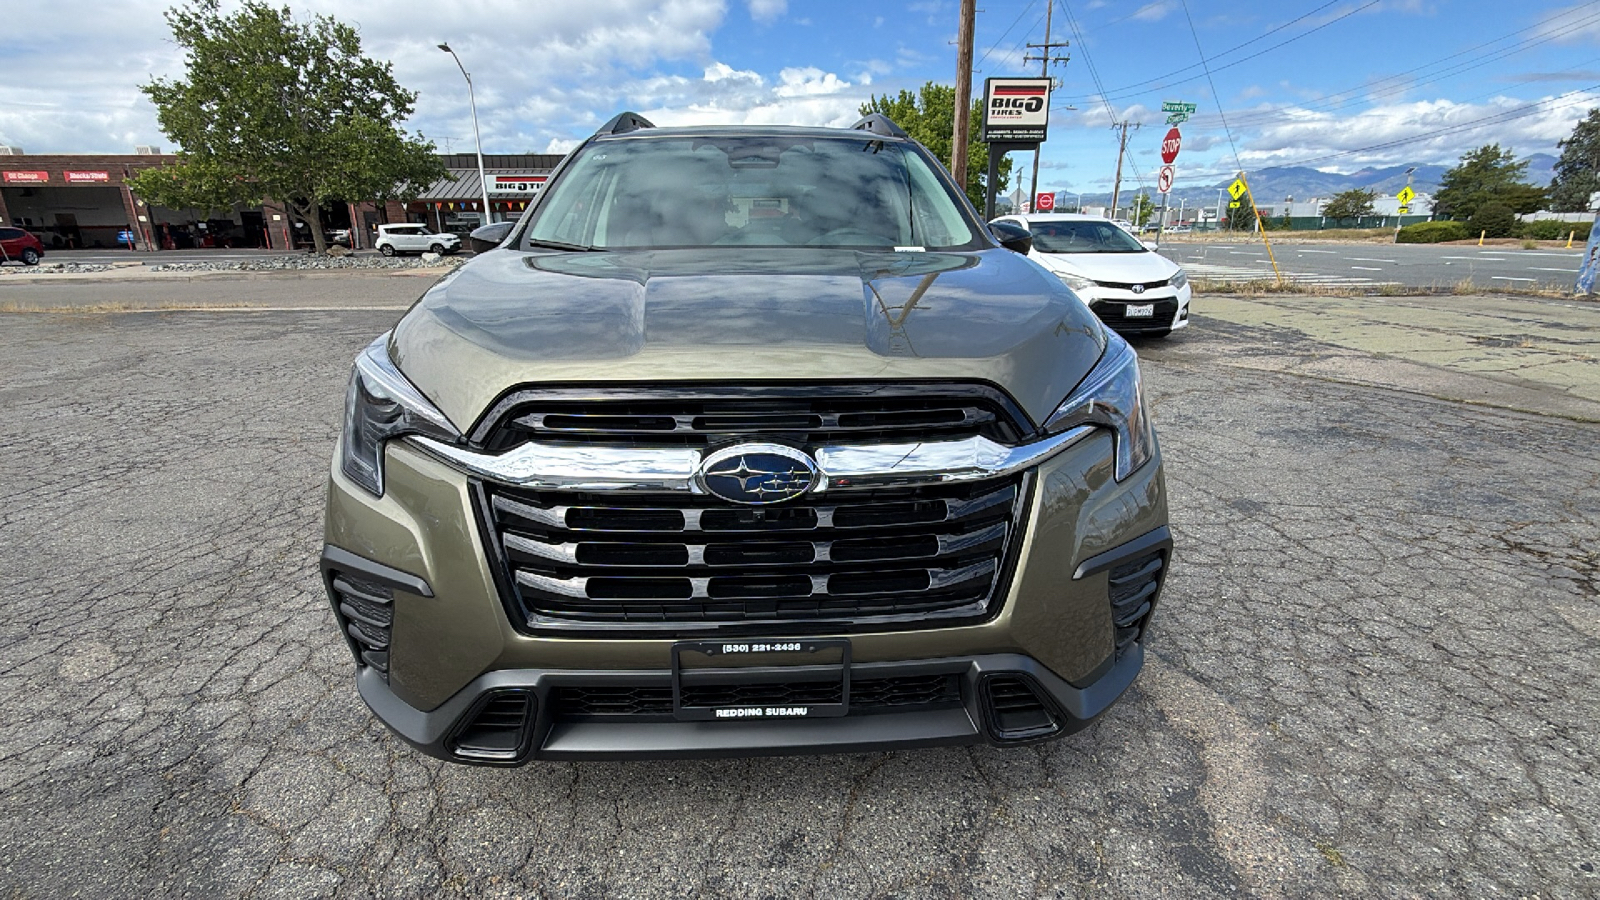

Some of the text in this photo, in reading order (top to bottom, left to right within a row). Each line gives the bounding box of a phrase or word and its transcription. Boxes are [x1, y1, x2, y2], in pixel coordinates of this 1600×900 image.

[991, 97, 1044, 112] BIG O
[1162, 103, 1188, 112] Beverly
[1162, 138, 1181, 153] STOP
[722, 643, 801, 653] (530) 221-2436
[716, 707, 807, 717] REDDING SUBARU
